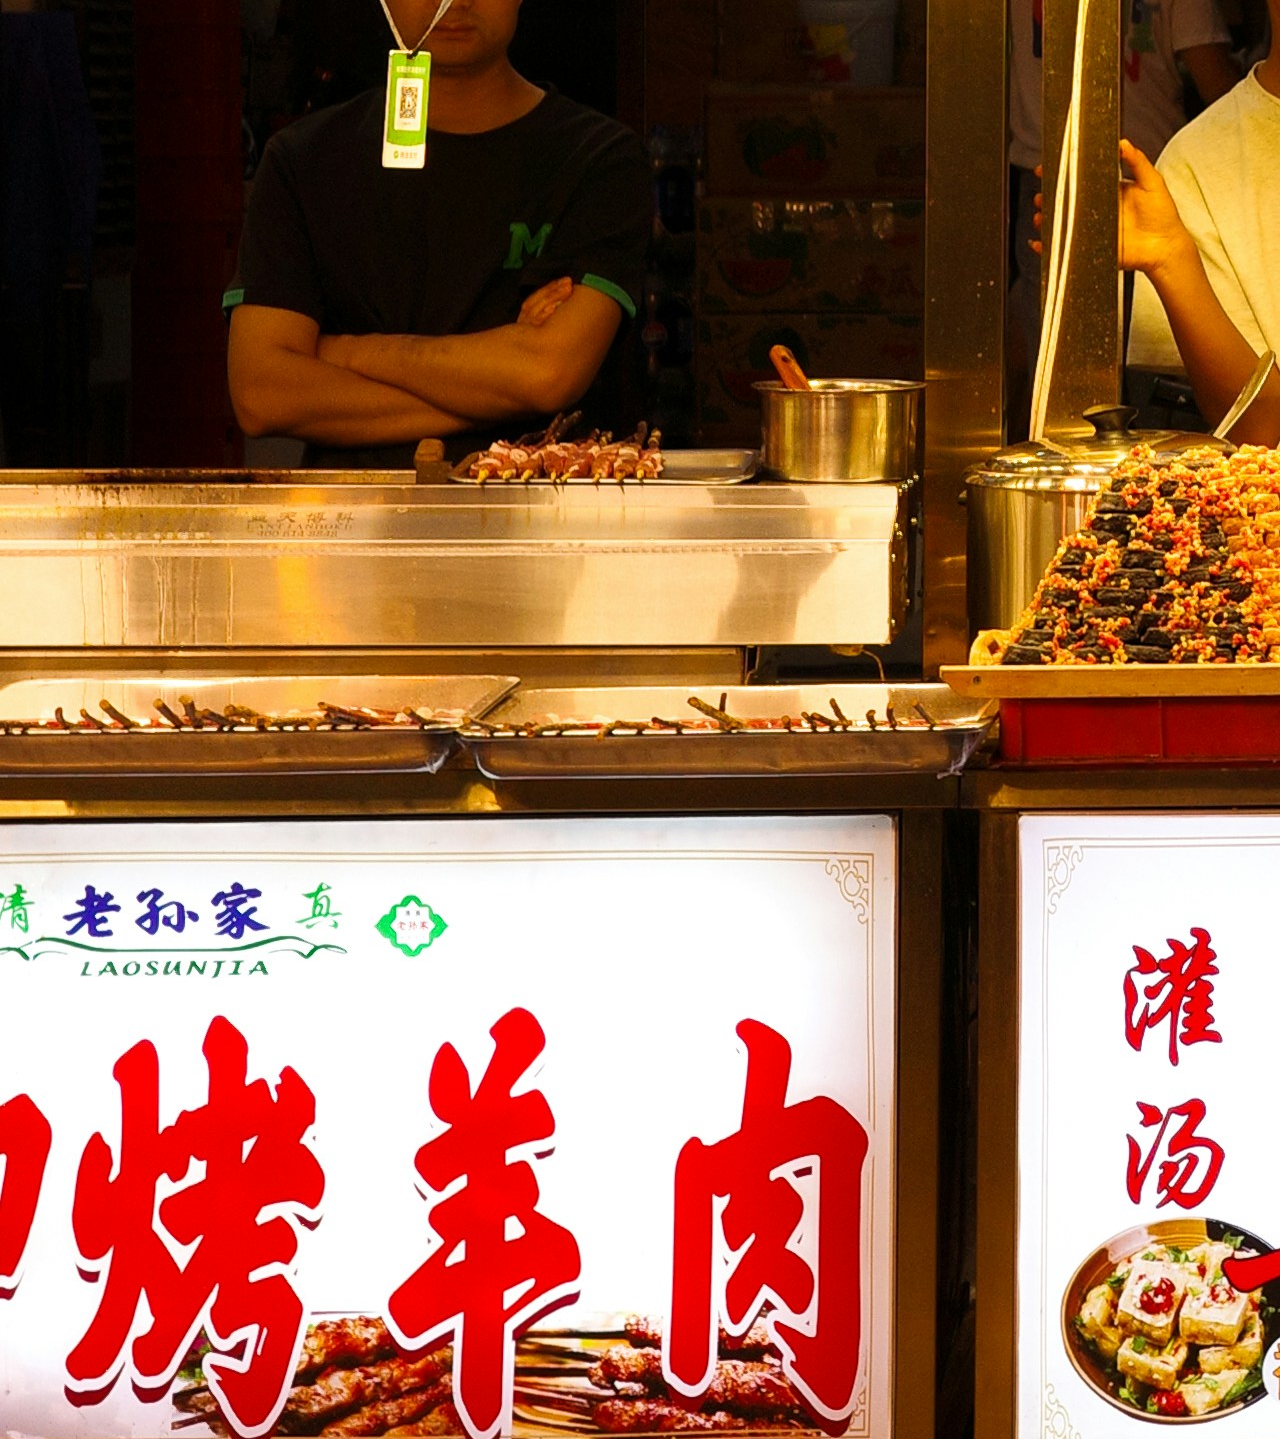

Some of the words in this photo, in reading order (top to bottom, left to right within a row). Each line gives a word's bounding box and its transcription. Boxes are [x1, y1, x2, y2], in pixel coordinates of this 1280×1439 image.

[503, 222, 553, 270] M
[64, 880, 268, 934] 老孙家
[296, 880, 342, 926] 真
[80, 948, 270, 969] LAOSUNJIA
[1124, 928, 1225, 1209] 灌汤
